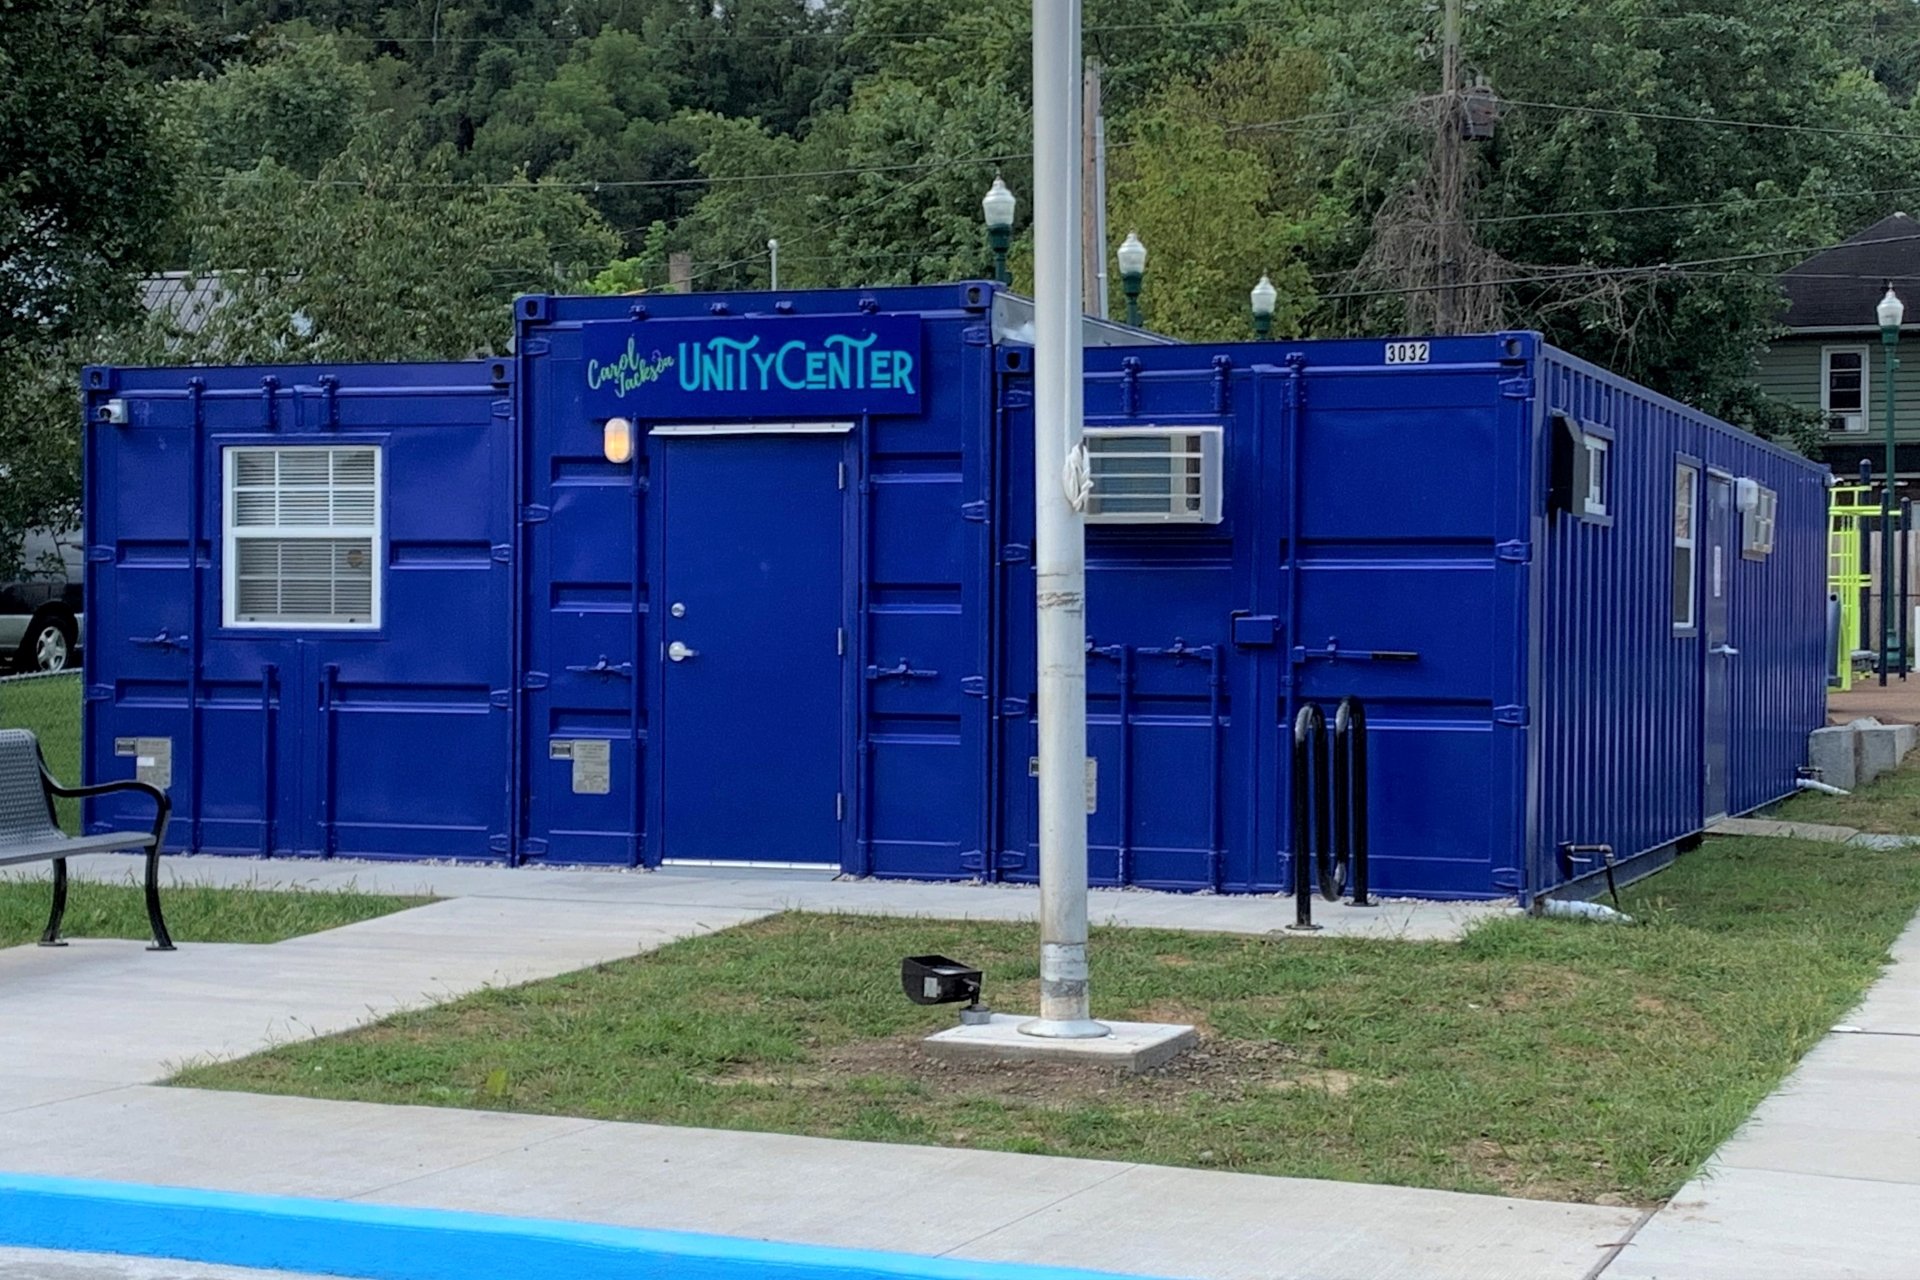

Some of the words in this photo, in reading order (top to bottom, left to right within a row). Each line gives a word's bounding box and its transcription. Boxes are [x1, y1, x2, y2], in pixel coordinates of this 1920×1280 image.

[588, 337, 640, 390] Carol
[1388, 343, 1427, 362] 3032
[614, 355, 674, 398] Jackson
